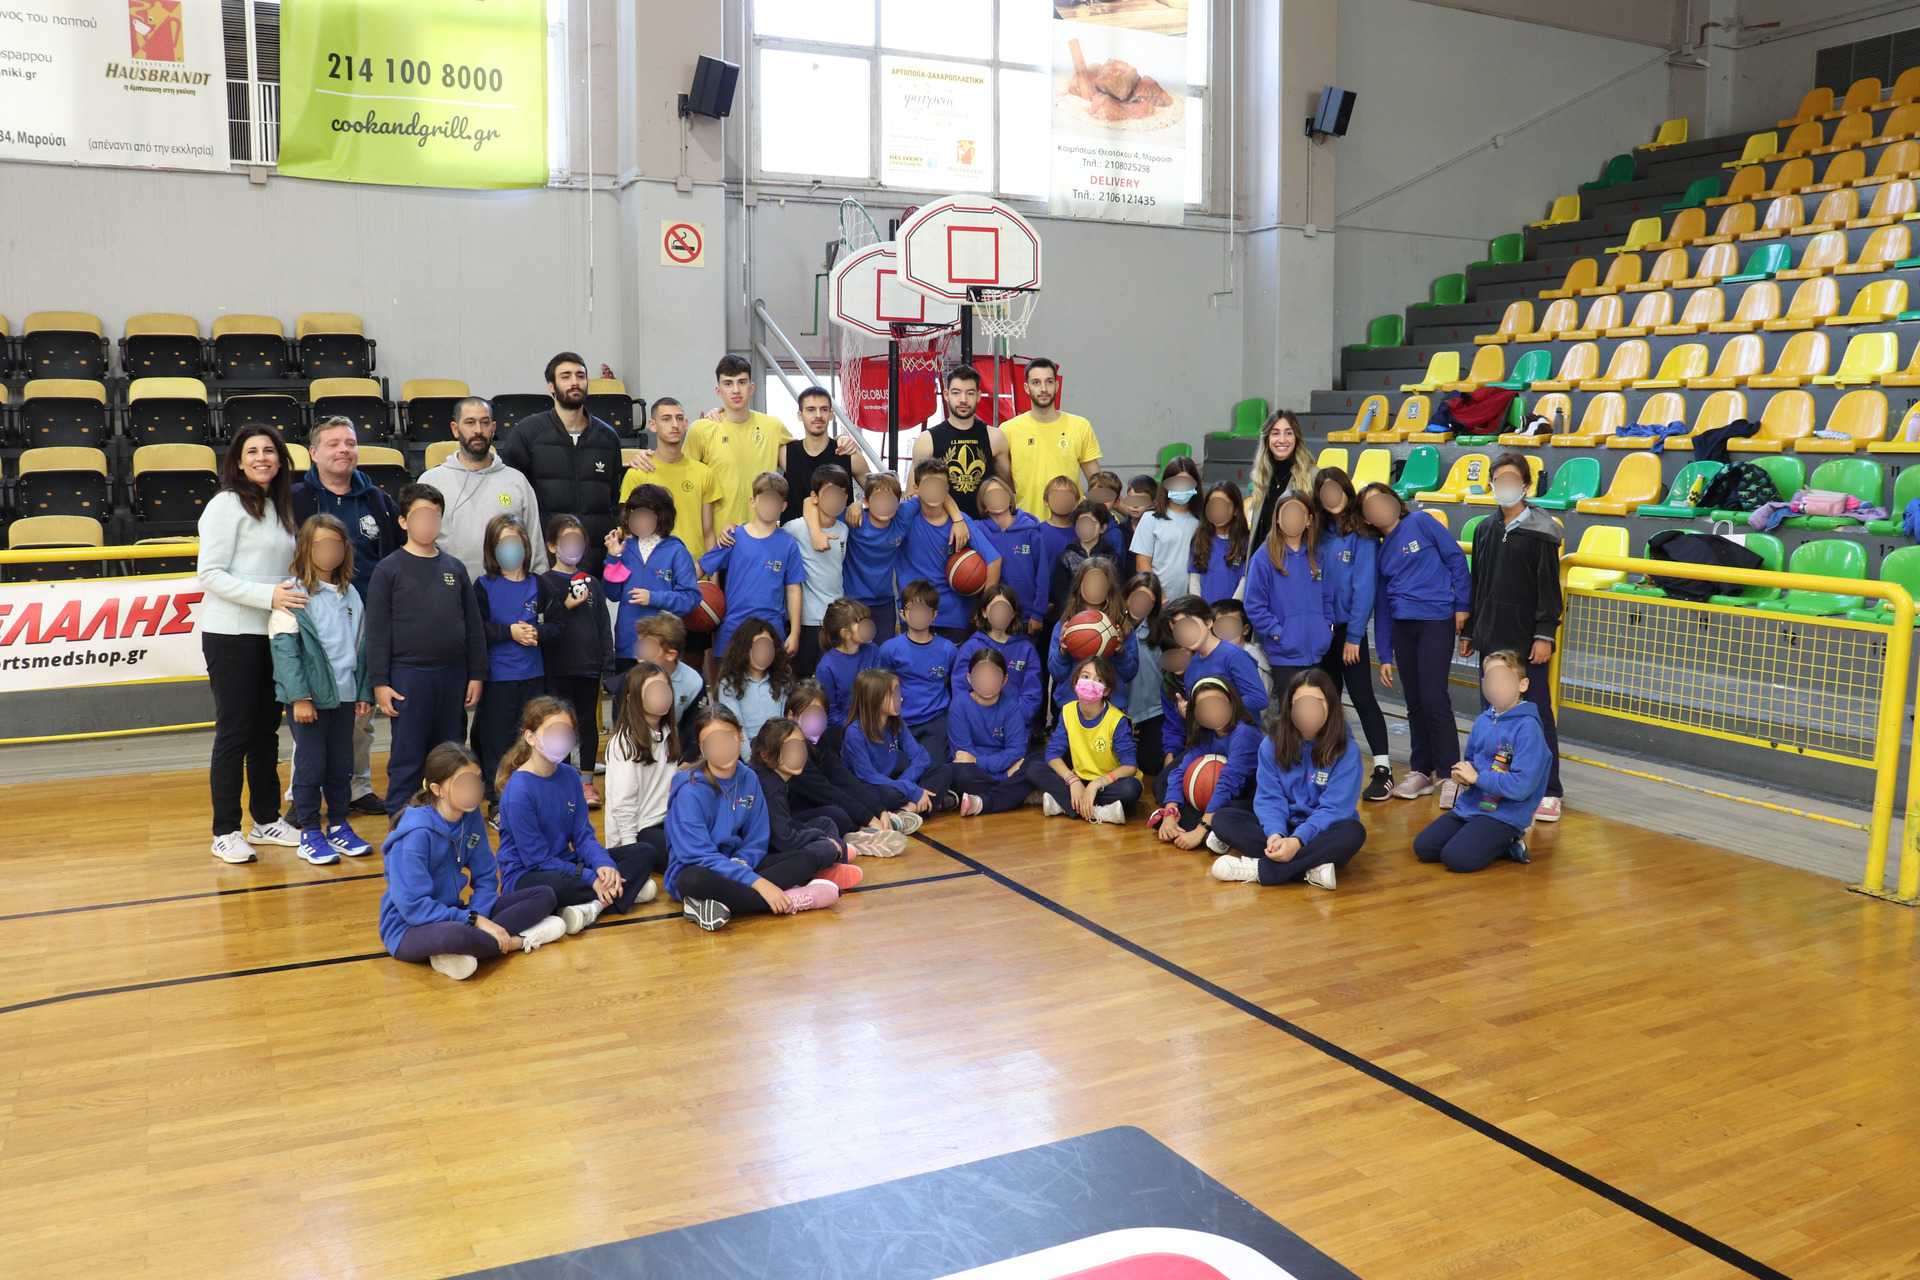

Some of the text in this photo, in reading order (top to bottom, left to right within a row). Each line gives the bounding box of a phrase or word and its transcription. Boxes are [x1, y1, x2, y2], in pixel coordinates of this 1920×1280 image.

[0, 10, 97, 28] νος του παππού
[0, 50, 52, 63] spappou
[0, 67, 38, 80] niki.gr
[105, 62, 212, 86] HAUSBRANDT
[328, 52, 503, 92] 214 100 8000
[331, 110, 501, 151] cookandgrill.gr
[17, 131, 66, 148] Μαρούσι
[88, 138, 214, 157] (απέναντι από την εκκλησία)
[1090, 175, 1140, 188] DELIVERY
[1099, 191, 1156, 206] 2106121435
[861, 389, 889, 400] GLOBUS
[0, 648, 148, 671] rtsmedshop.gr
